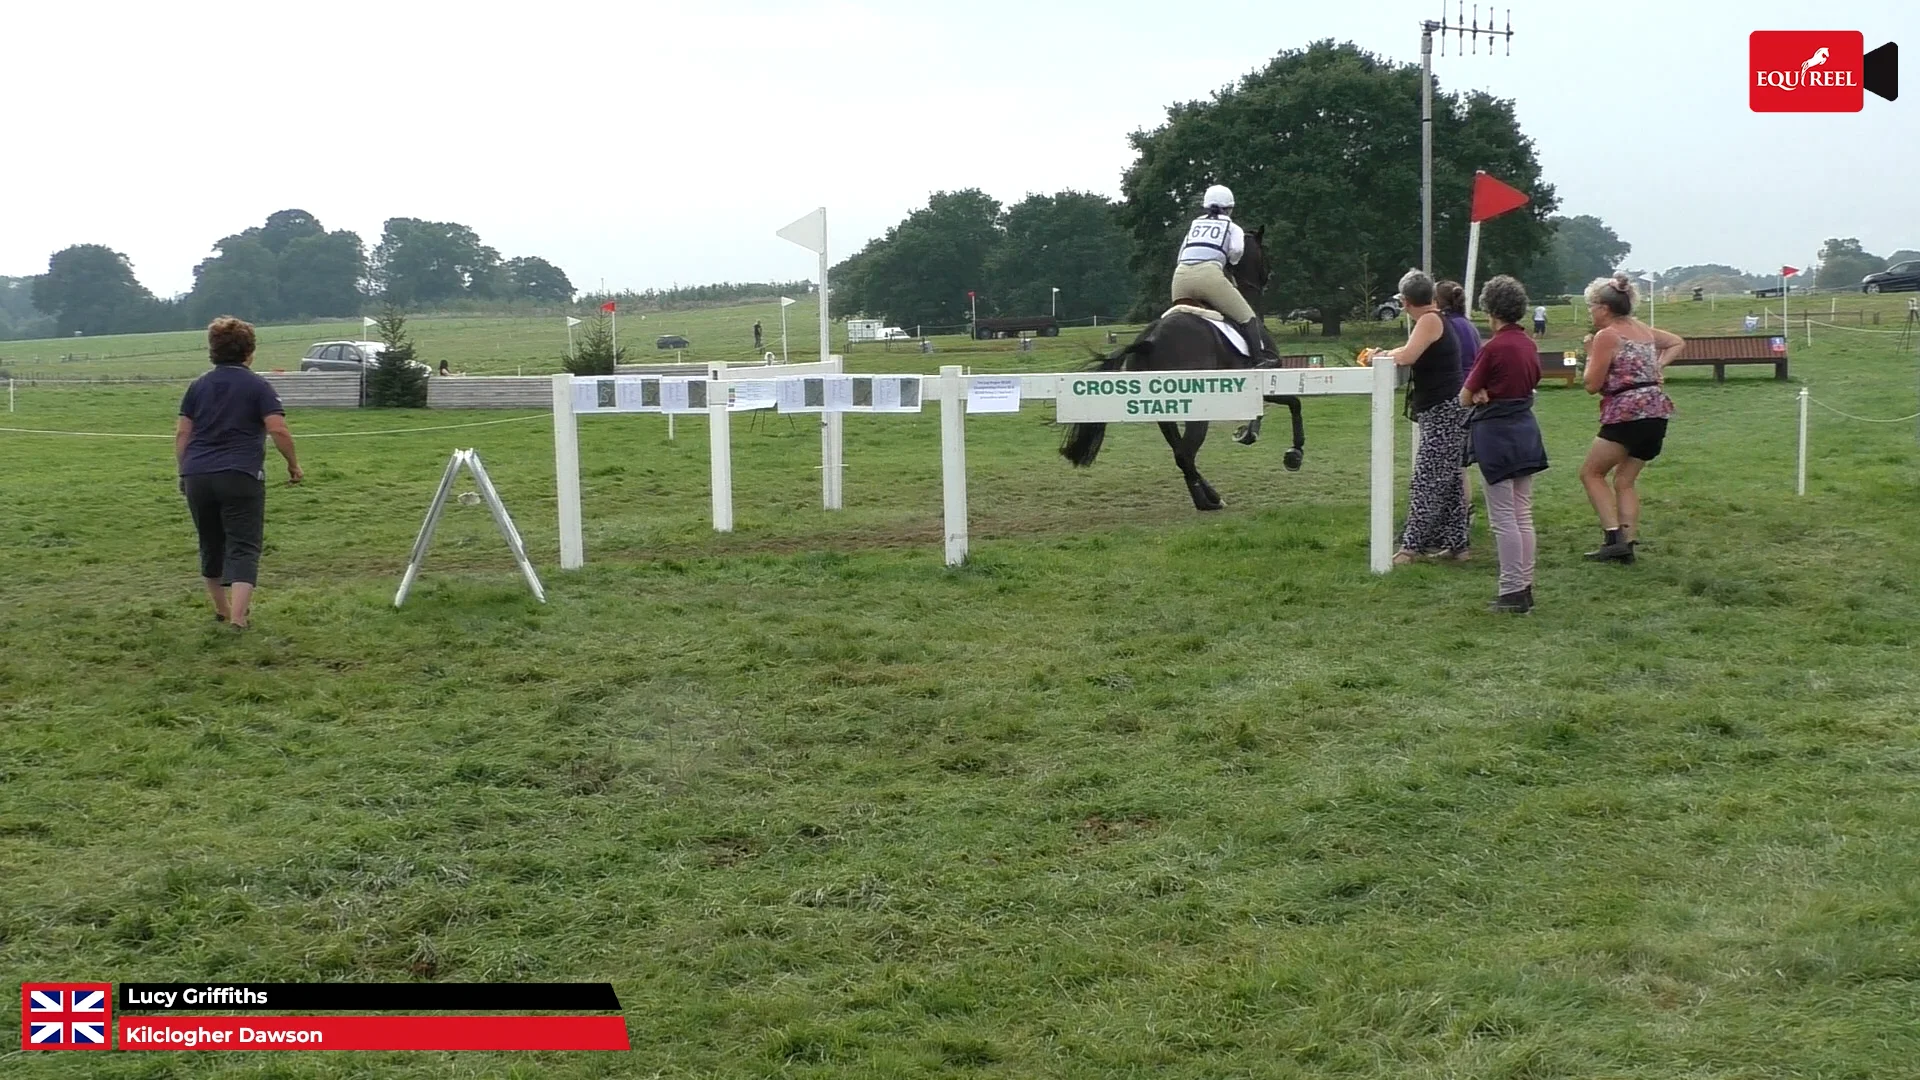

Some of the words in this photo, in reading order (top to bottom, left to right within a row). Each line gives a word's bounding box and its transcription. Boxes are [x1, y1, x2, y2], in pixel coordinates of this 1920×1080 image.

[1191, 225, 1221, 239] 670
[1073, 379, 1142, 395] CROSS
[1149, 377, 1247, 394] COUNTRY
[1126, 399, 1193, 414] START
